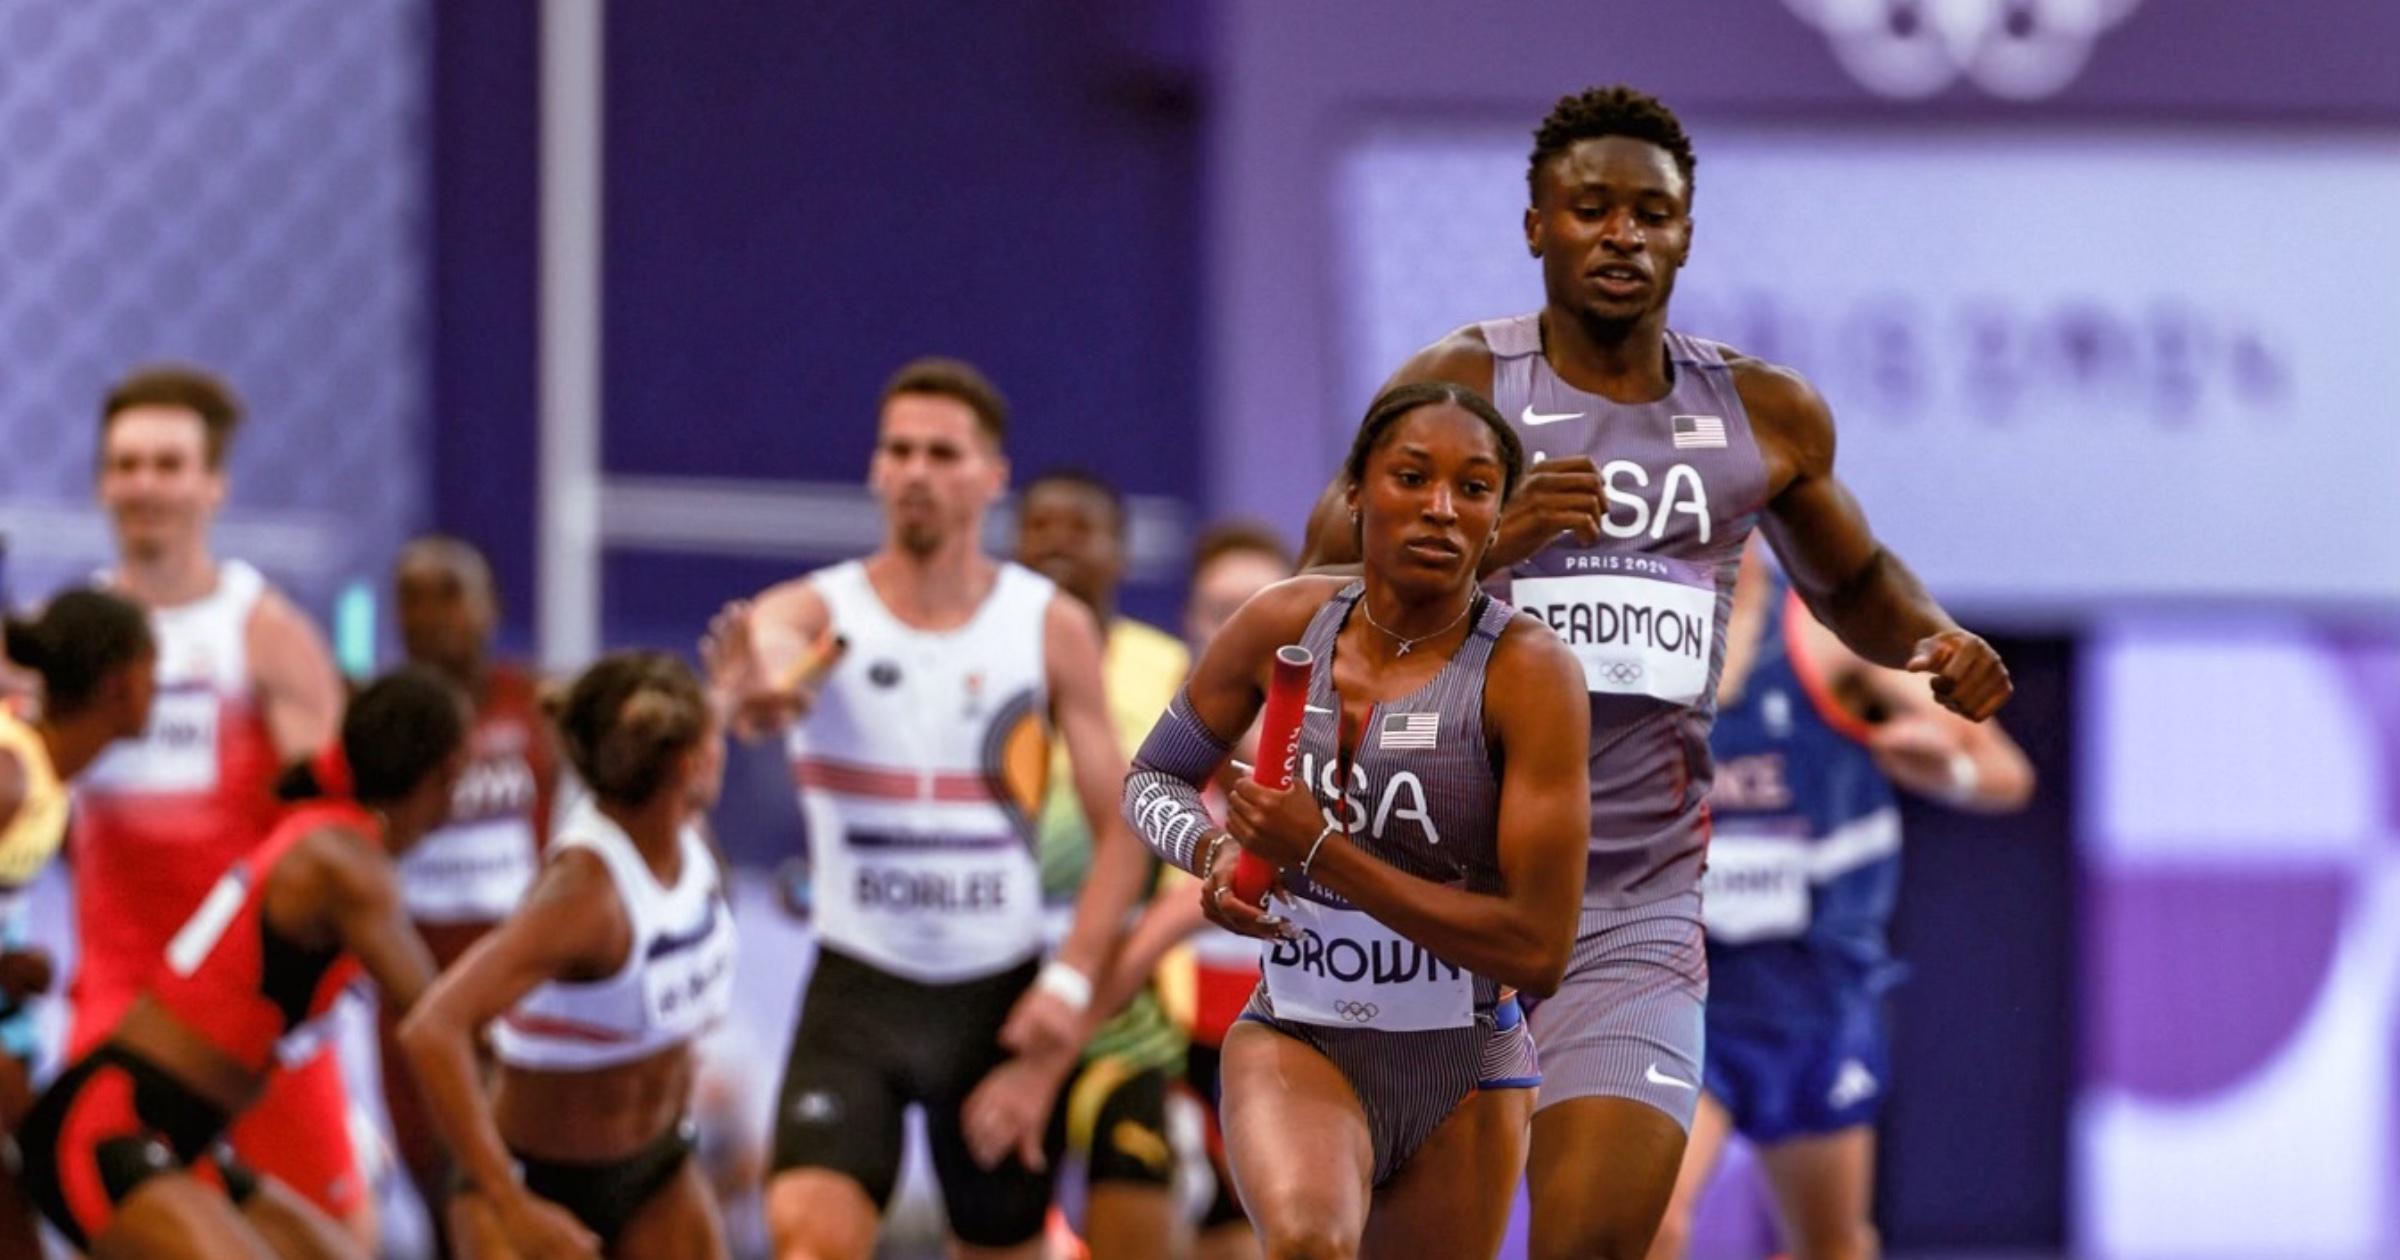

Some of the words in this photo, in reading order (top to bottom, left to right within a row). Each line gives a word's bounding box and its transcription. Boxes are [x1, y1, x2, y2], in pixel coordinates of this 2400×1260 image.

[1533, 451, 1712, 544] SA
[1565, 556, 1620, 570] PARIS
[1624, 557, 1668, 575] 2024
[1521, 602, 1704, 659] EADMON
